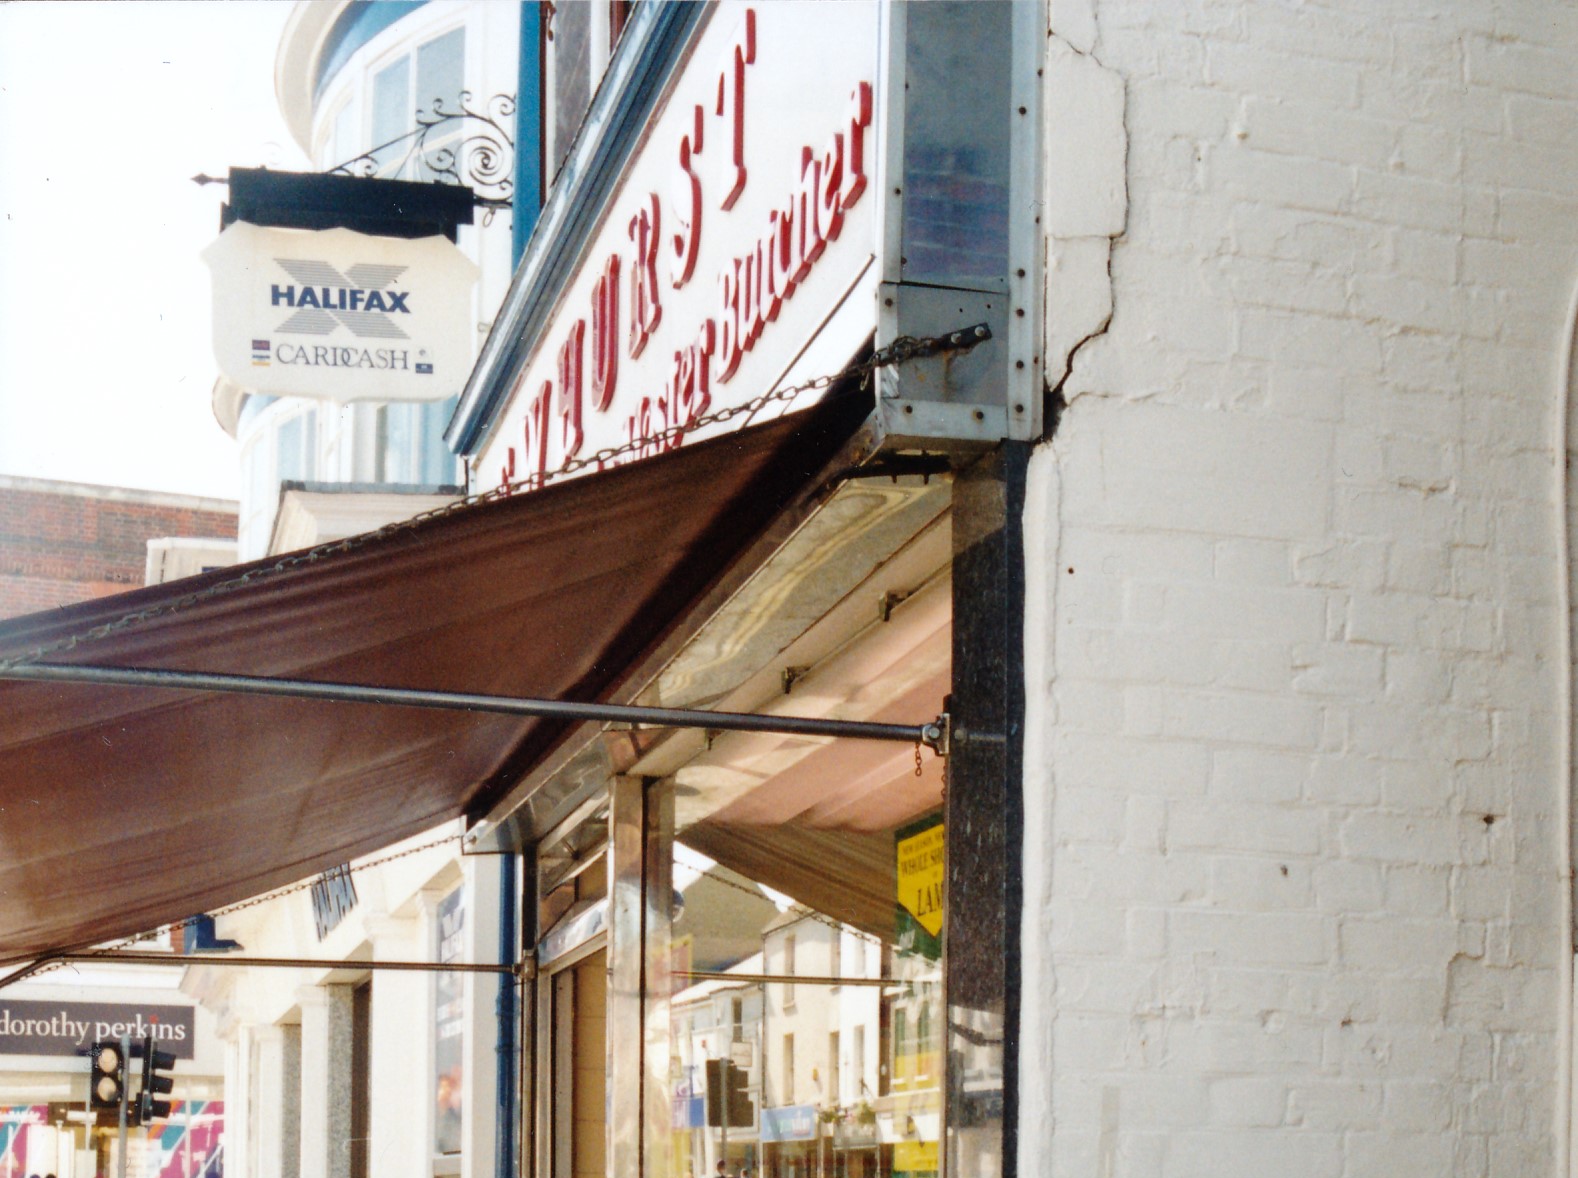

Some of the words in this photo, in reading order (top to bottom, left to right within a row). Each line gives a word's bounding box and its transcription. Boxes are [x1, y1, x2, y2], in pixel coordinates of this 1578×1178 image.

[715, 80, 874, 385] Butcher
[271, 284, 411, 314] HALIFAX
[0, 1009, 90, 1046] dorothy
[95, 1013, 186, 1044] perkins
